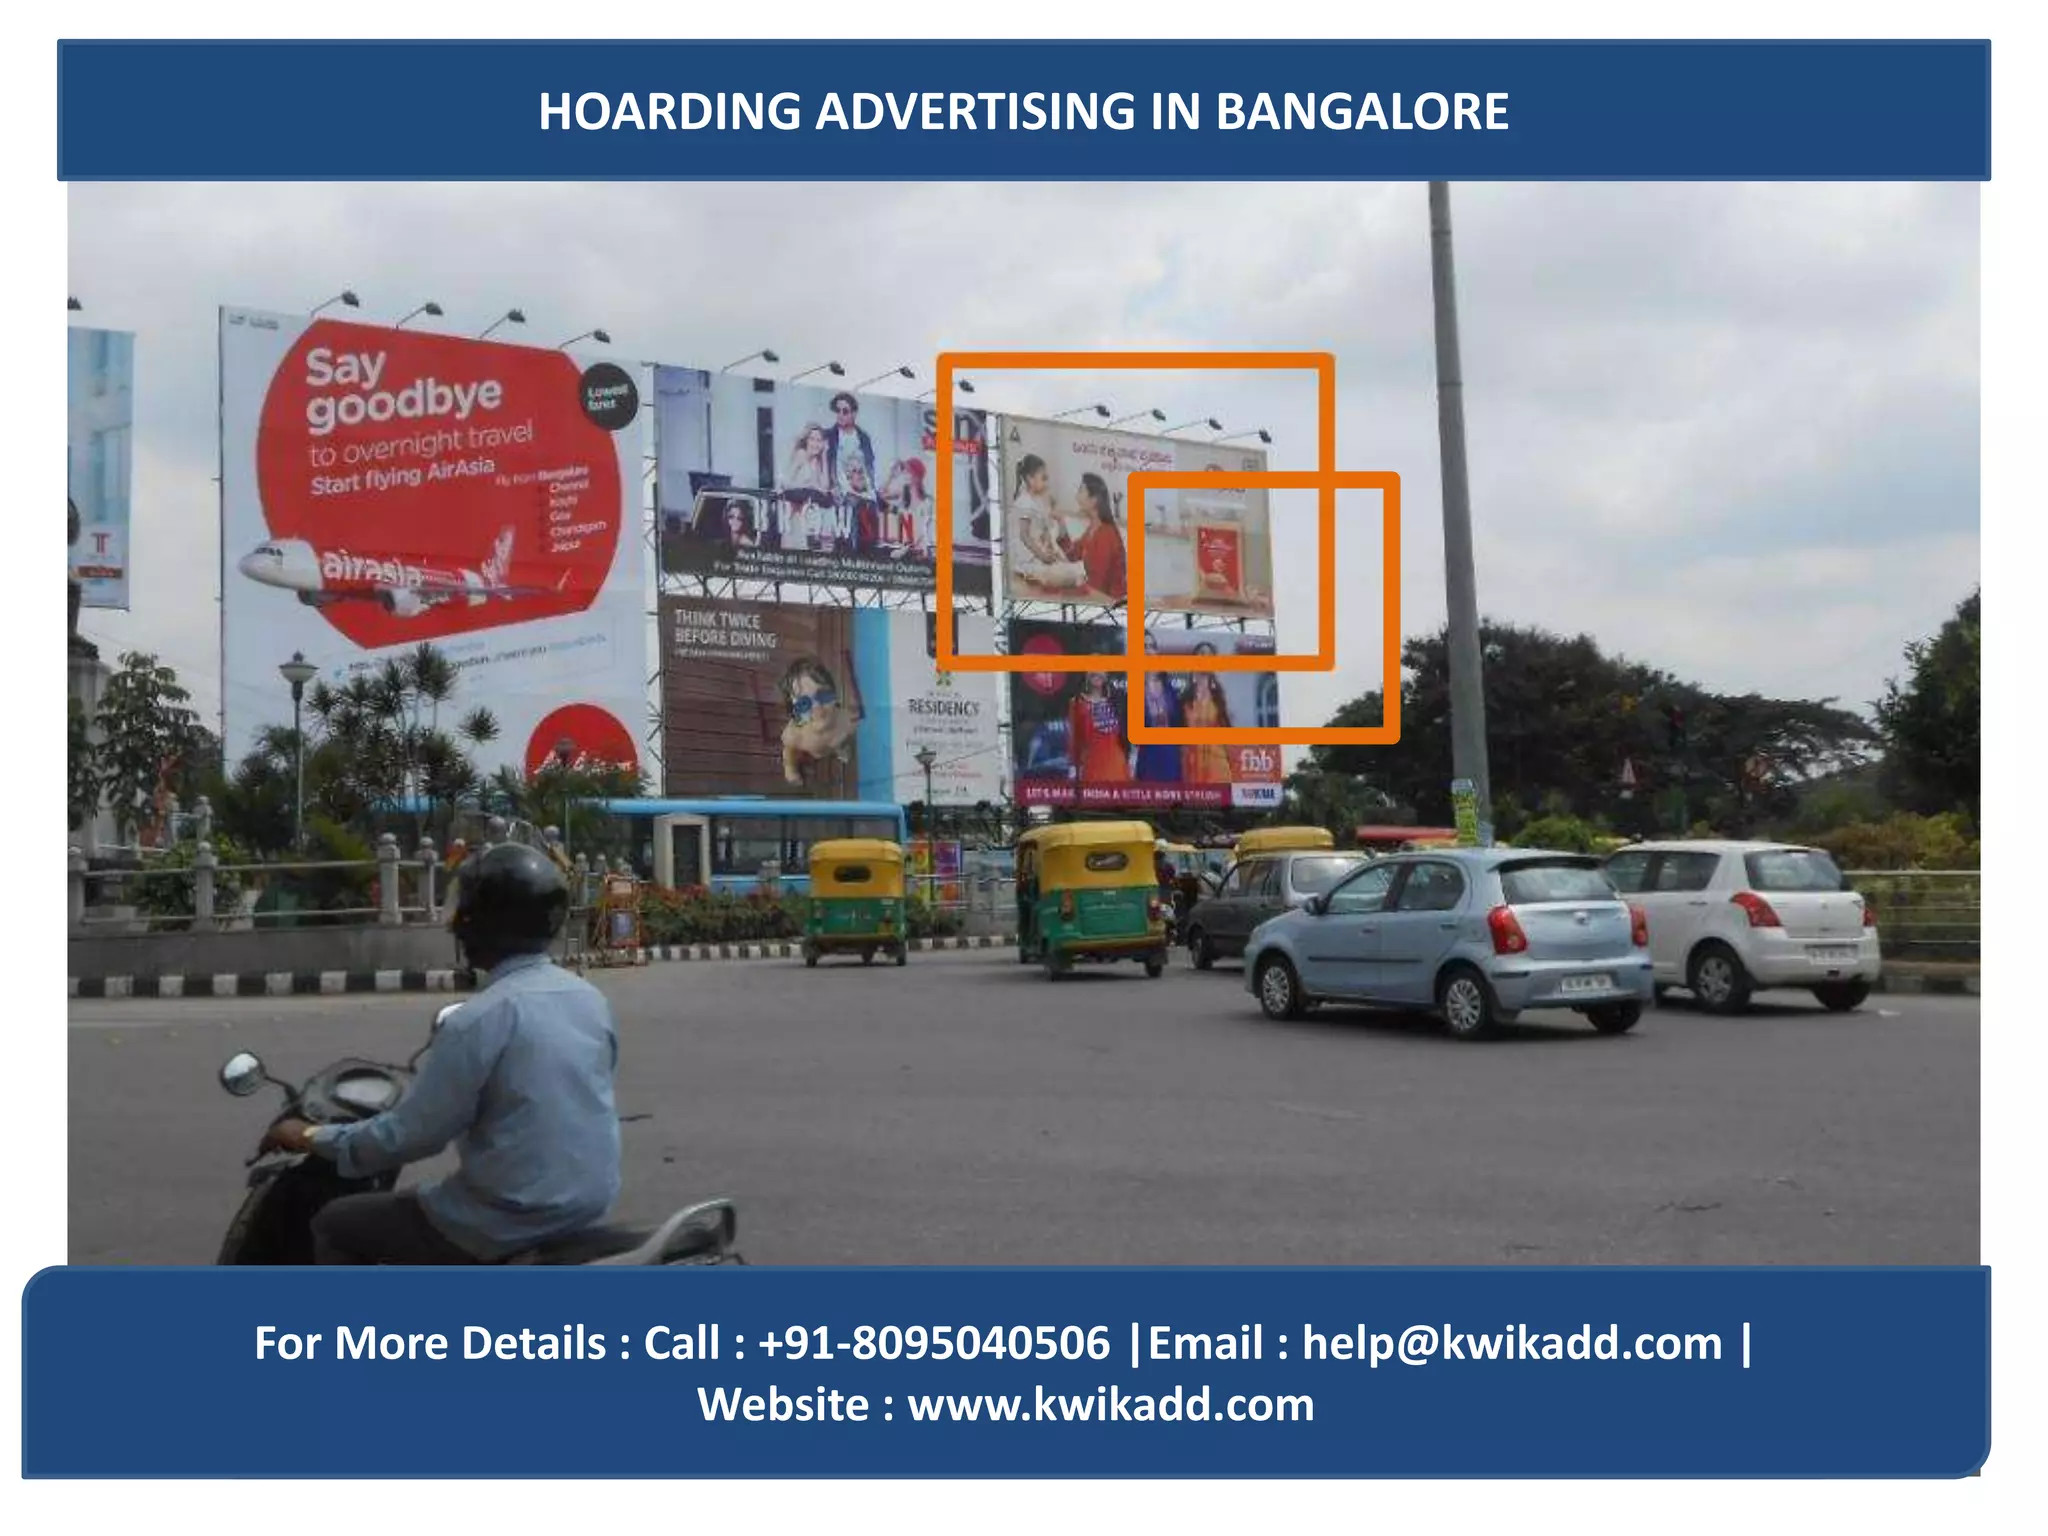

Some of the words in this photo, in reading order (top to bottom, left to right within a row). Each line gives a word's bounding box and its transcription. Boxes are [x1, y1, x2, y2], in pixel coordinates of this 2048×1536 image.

[306, 348, 386, 390] Say
[306, 377, 503, 436] goodbye
[312, 446, 336, 467] to
[343, 428, 462, 458] overnight
[468, 418, 533, 447] travel
[312, 474, 360, 495] Start
[365, 467, 421, 491] flying
[427, 456, 495, 481] AirAsia
[323, 549, 424, 588] airasia
[675, 608, 717, 627] THINK
[719, 611, 761, 629] TWICE
[675, 627, 728, 646] BEFORE
[730, 630, 777, 648] DIVING
[908, 698, 979, 717] RESIDENCY
